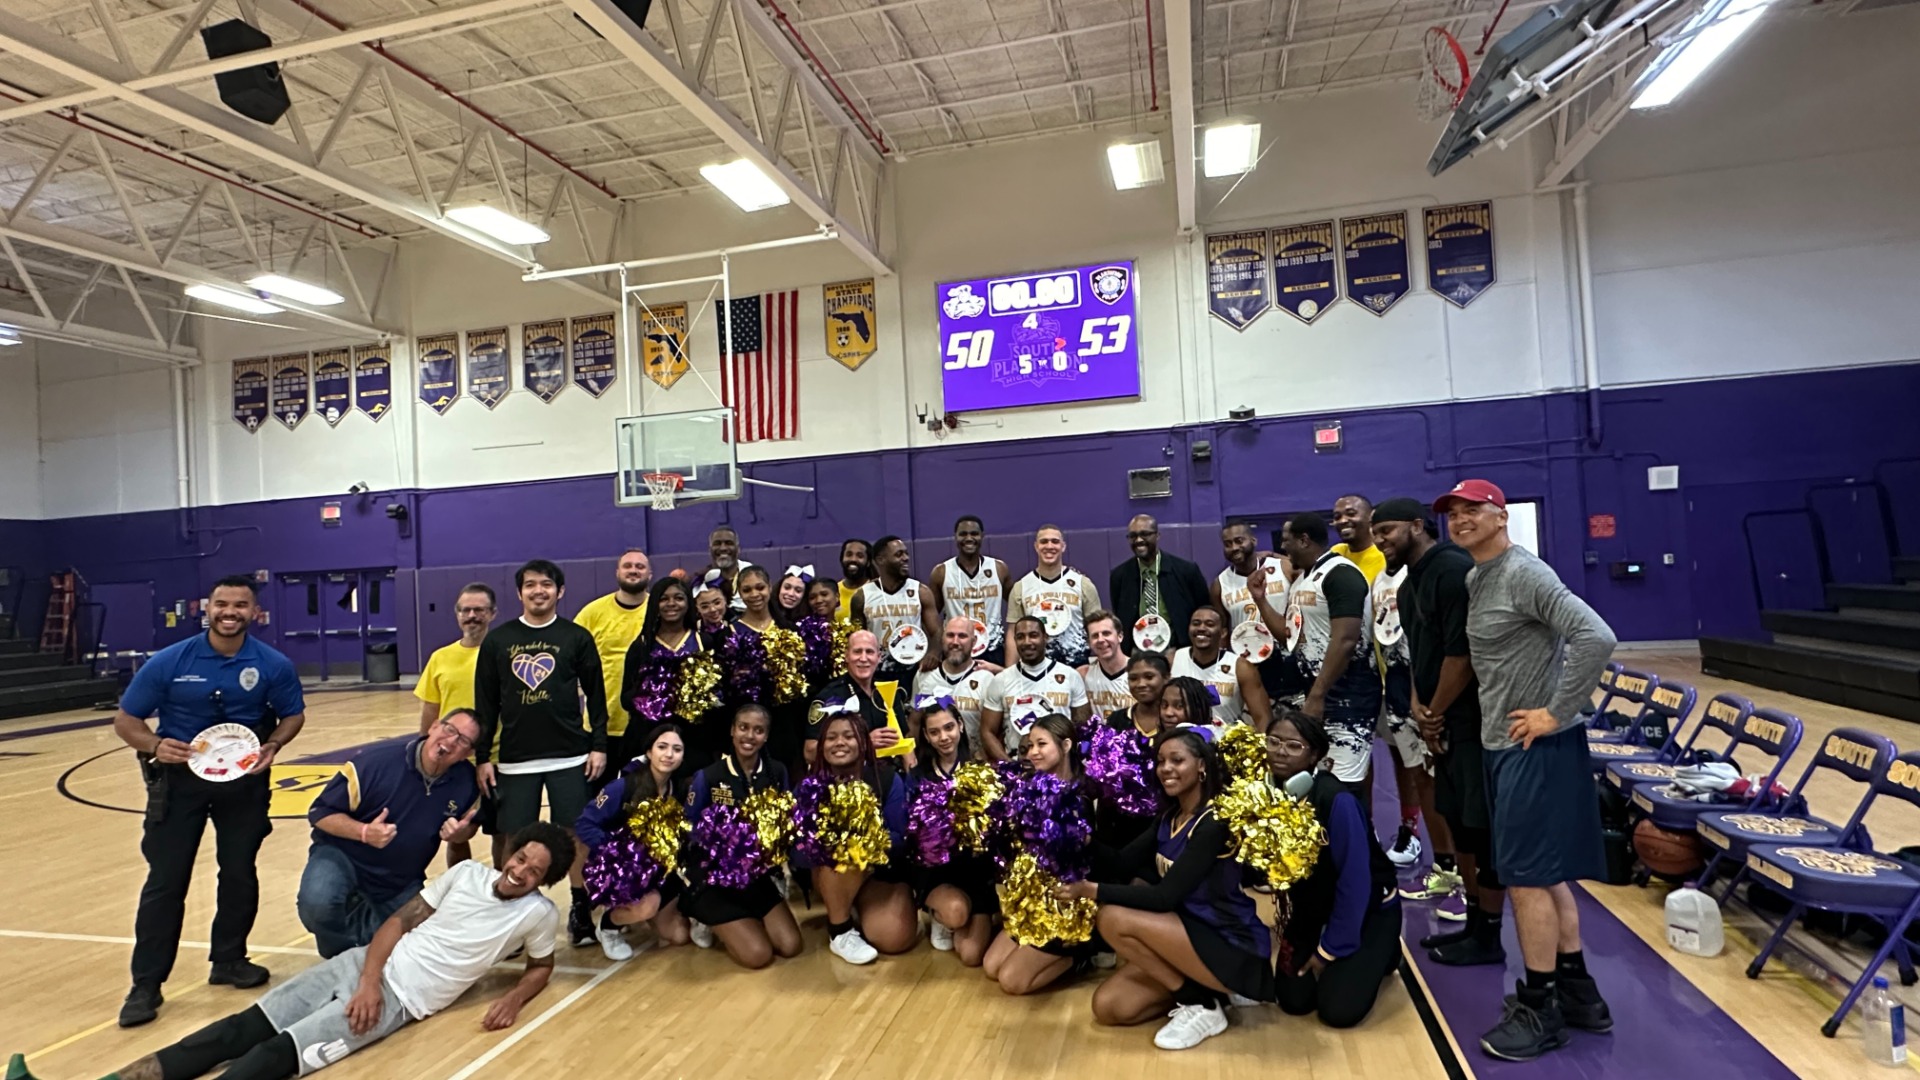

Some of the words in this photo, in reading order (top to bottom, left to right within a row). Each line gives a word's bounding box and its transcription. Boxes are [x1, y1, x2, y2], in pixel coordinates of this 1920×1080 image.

[1345, 219, 1404, 248] CHAMPIONS
[1428, 208, 1489, 237] CHAMPIONS
[1209, 236, 1266, 262] CHAMPIONS
[1274, 227, 1332, 257] CHAMPIONS
[826, 293, 873, 318] CHAMPIONS
[835, 288, 863, 296] STATE
[1022, 312, 1038, 329] 4
[1077, 315, 1131, 356] 53
[944, 329, 995, 370] 50
[1019, 354, 1032, 374] 5
[1053, 351, 1067, 371] 0
[1615, 673, 1649, 695] SOUTH
[1651, 686, 1684, 710] SOUTH
[1615, 725, 1663, 738] POICE
[1744, 715, 1787, 745] SOUTH
[1825, 735, 1878, 770] SOUTH
[1886, 759, 1920, 793] SO
